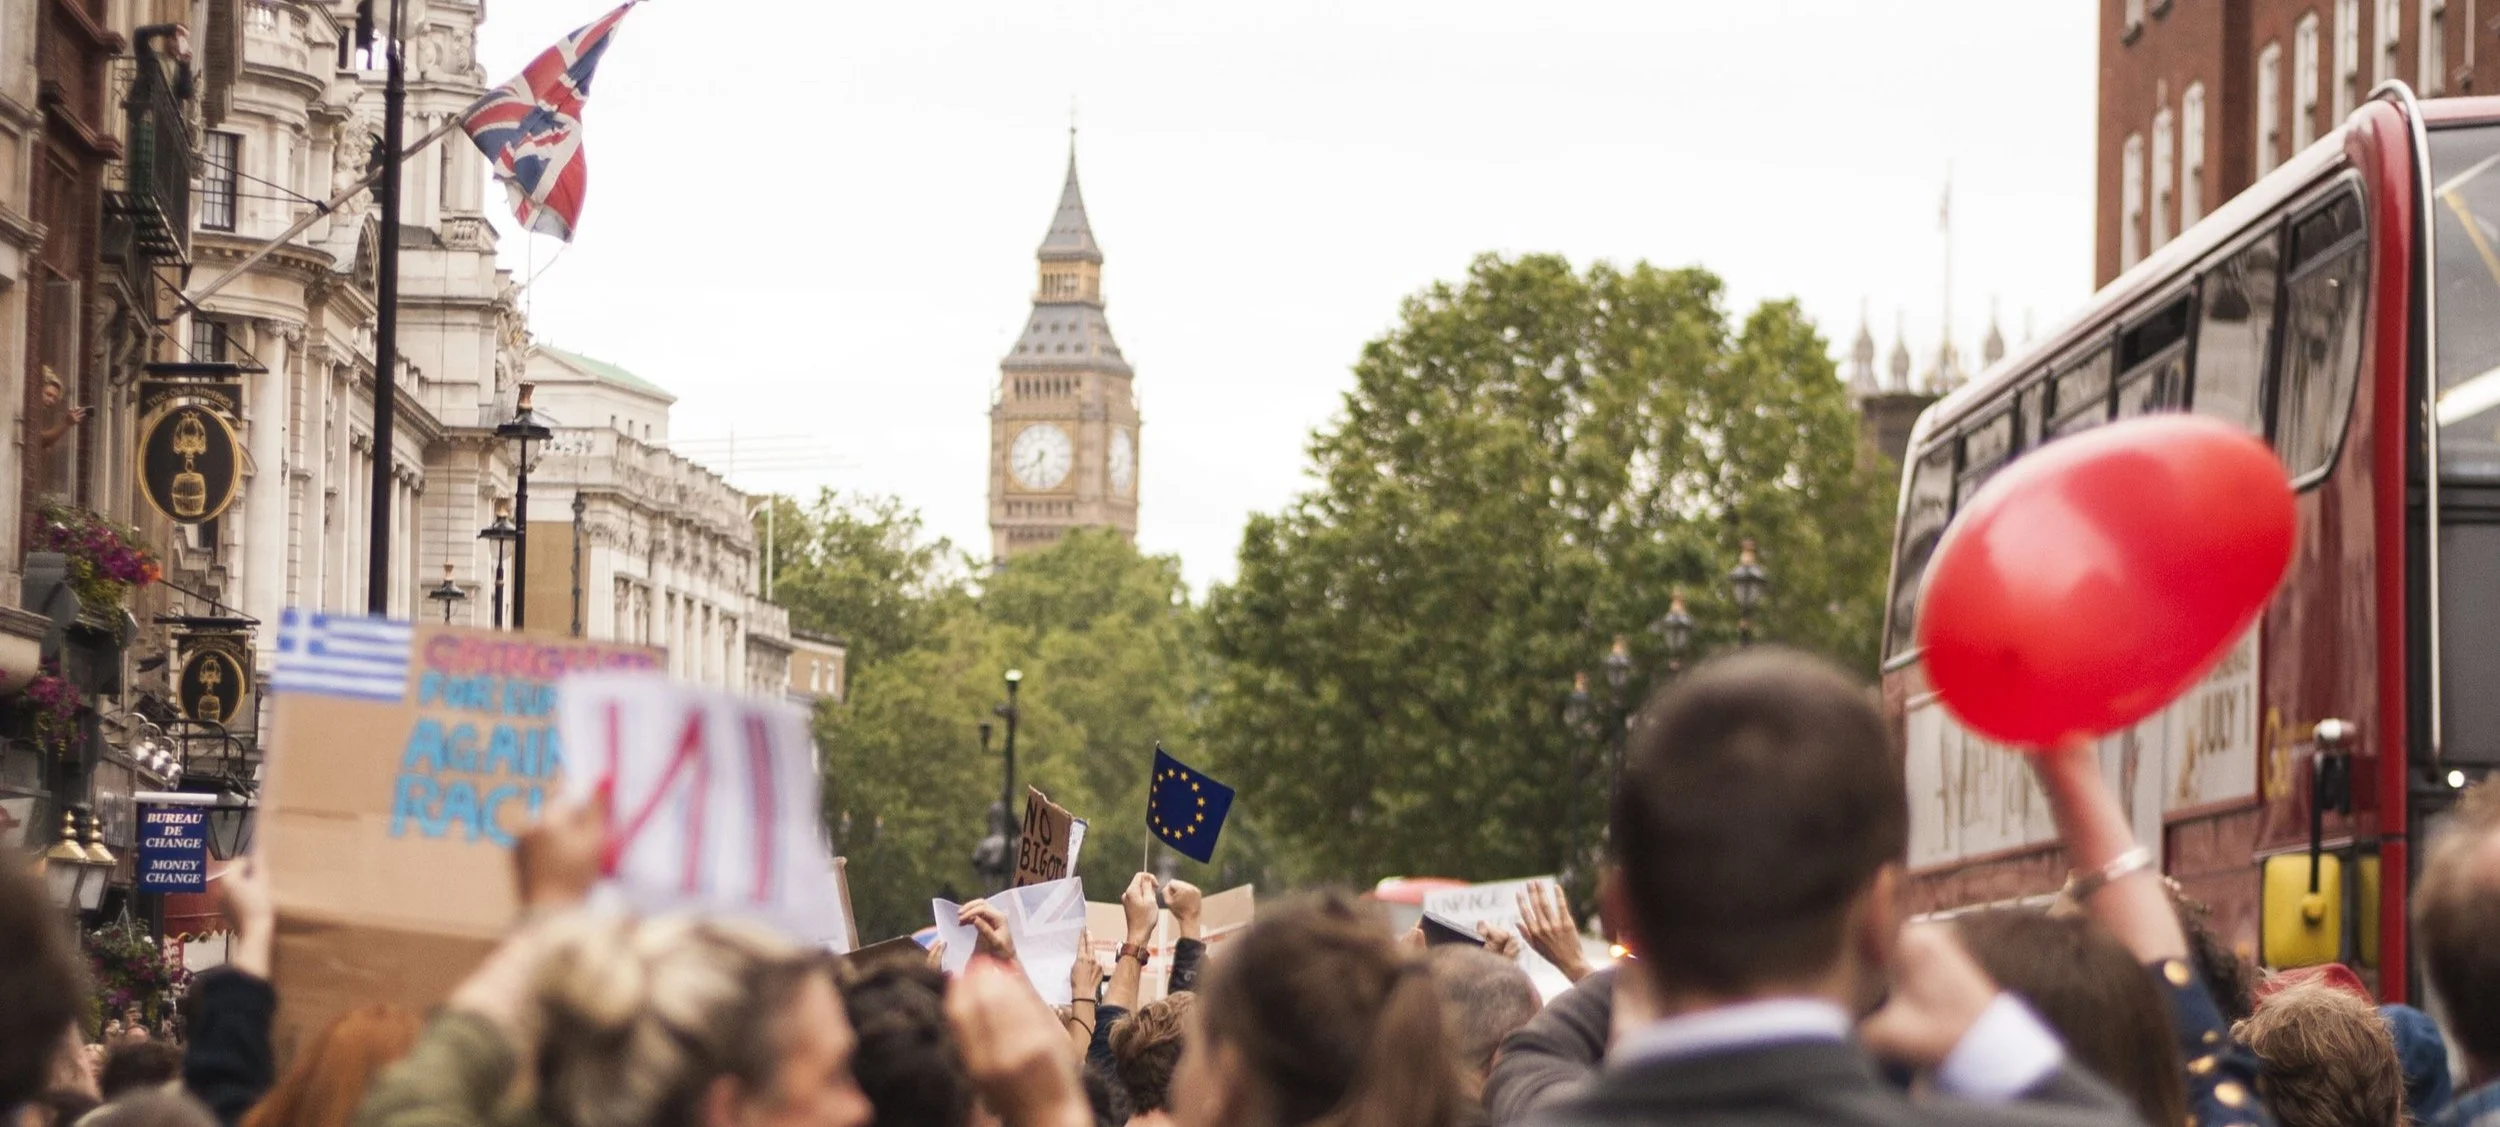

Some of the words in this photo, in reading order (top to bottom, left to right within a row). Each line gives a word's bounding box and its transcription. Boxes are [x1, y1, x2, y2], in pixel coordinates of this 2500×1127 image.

[147, 813, 203, 824] BUREAU
[1023, 795, 1052, 846] NO
[164, 826, 183, 836] DE
[145, 838, 202, 848] CHANGE
[151, 860, 199, 870] MONEY
[145, 873, 201, 883] CHANGE
